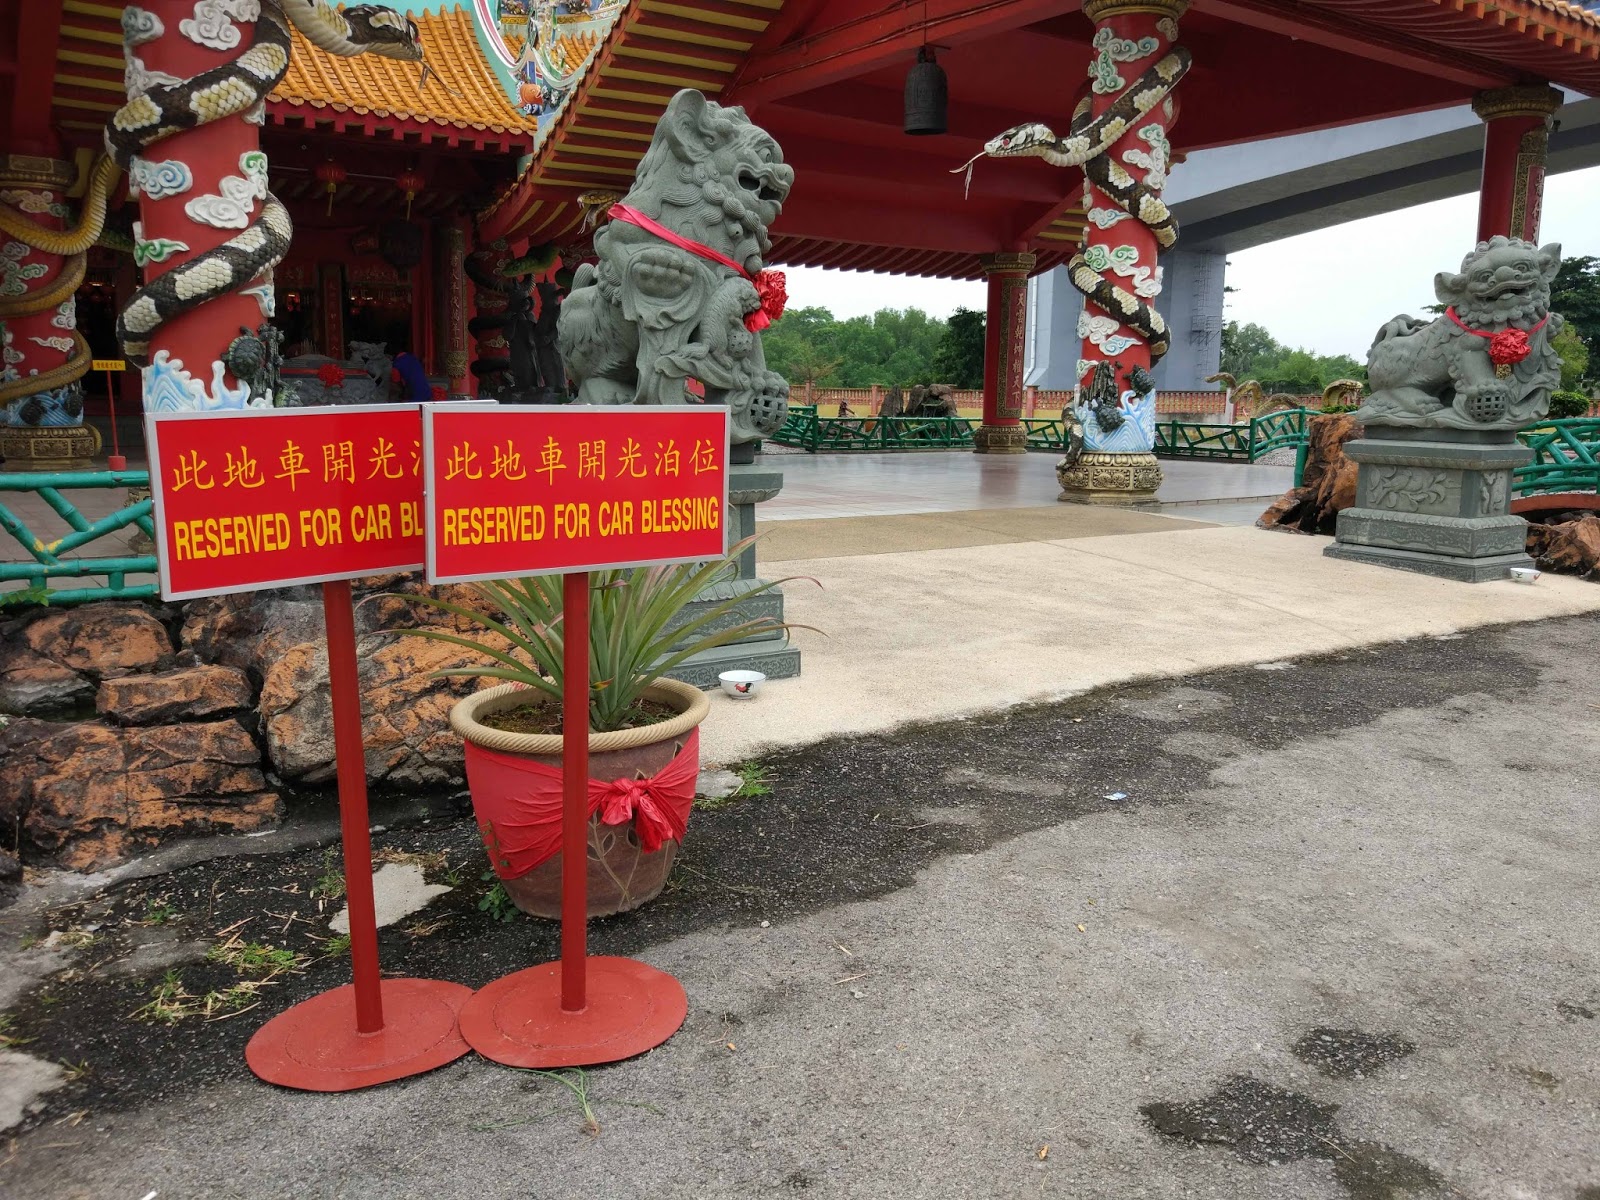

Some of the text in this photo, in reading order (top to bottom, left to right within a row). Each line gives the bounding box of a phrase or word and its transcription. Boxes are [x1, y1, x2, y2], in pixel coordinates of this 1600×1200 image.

[444, 436, 719, 486] 此地車開光泊位
[174, 512, 291, 561] RESERVED
[300, 508, 343, 548] FOR
[351, 503, 393, 543] CAR
[443, 496, 719, 546] RESERVED FOR CAR BLESSING
